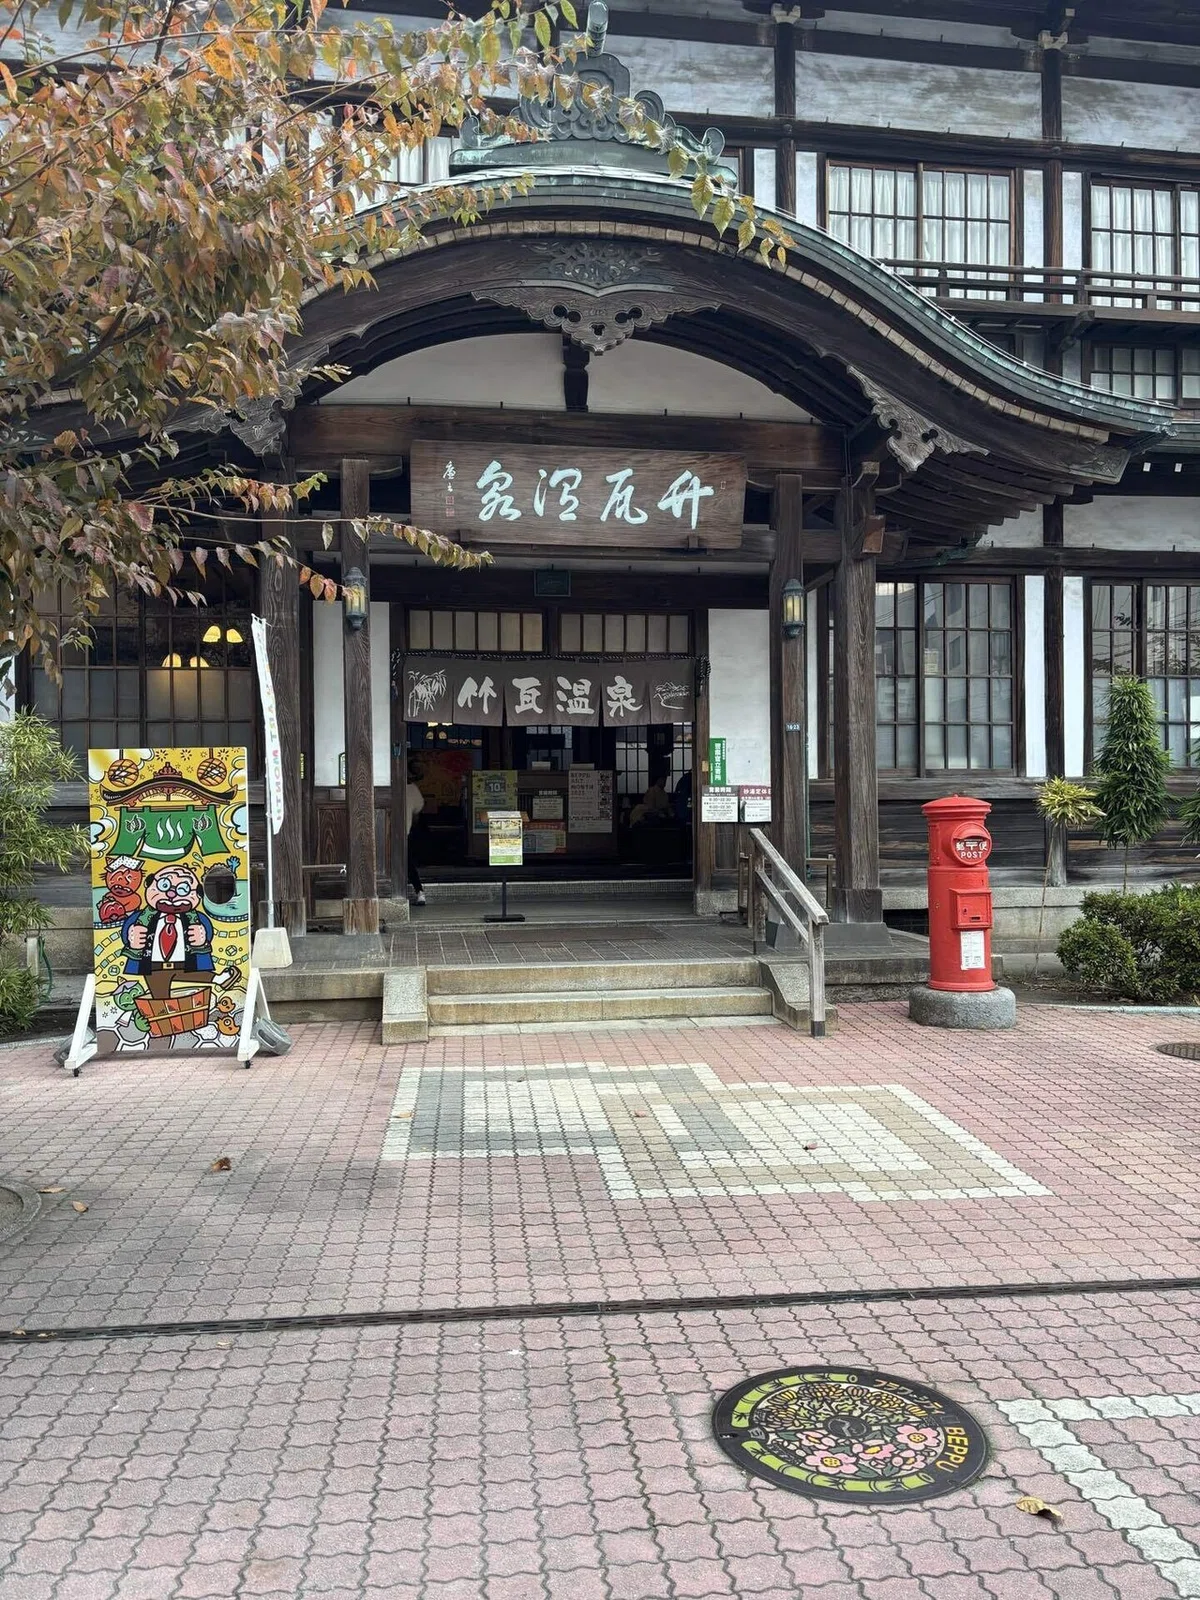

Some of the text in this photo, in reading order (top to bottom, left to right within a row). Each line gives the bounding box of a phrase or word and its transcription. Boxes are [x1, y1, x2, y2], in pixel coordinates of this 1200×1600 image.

[457, 675, 643, 718] 竹瓦温泉
[961, 851, 983, 859] POST
[935, 1426, 969, 1473] BEPPU
